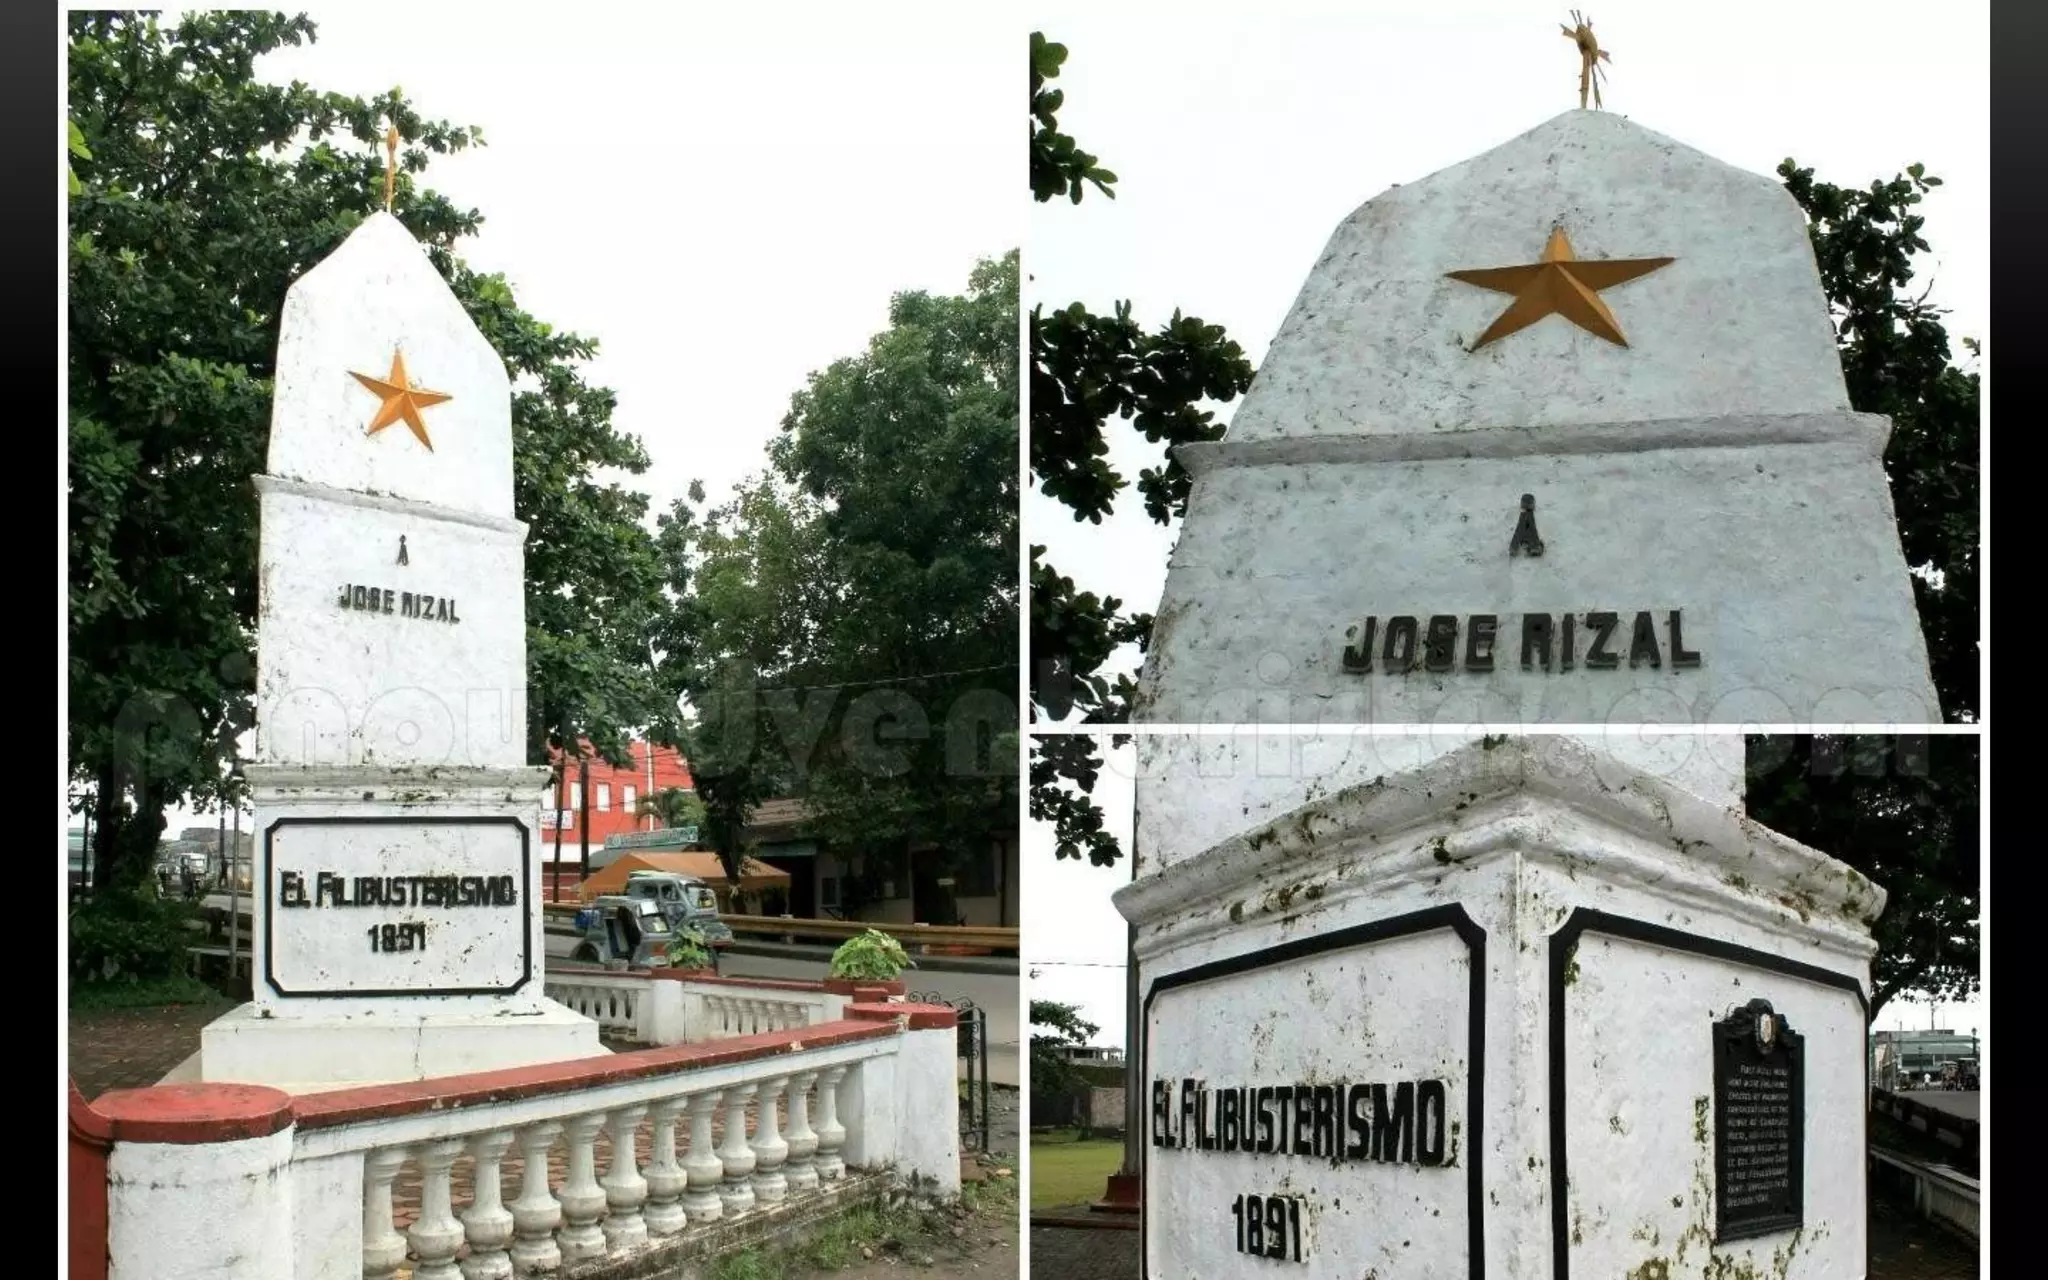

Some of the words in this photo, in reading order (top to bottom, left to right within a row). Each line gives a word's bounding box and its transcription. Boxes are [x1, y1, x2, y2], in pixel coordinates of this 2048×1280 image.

[338, 583, 395, 616] JOSE
[401, 591, 461, 625] RIZAL
[1342, 612, 1498, 674] JOSE
[1520, 608, 1702, 672] RIZAL
[368, 922, 427, 953] 1891
[1181, 1078, 1453, 1168] FILIBUSTERISMO
[1231, 1193, 1306, 1264] 1891
